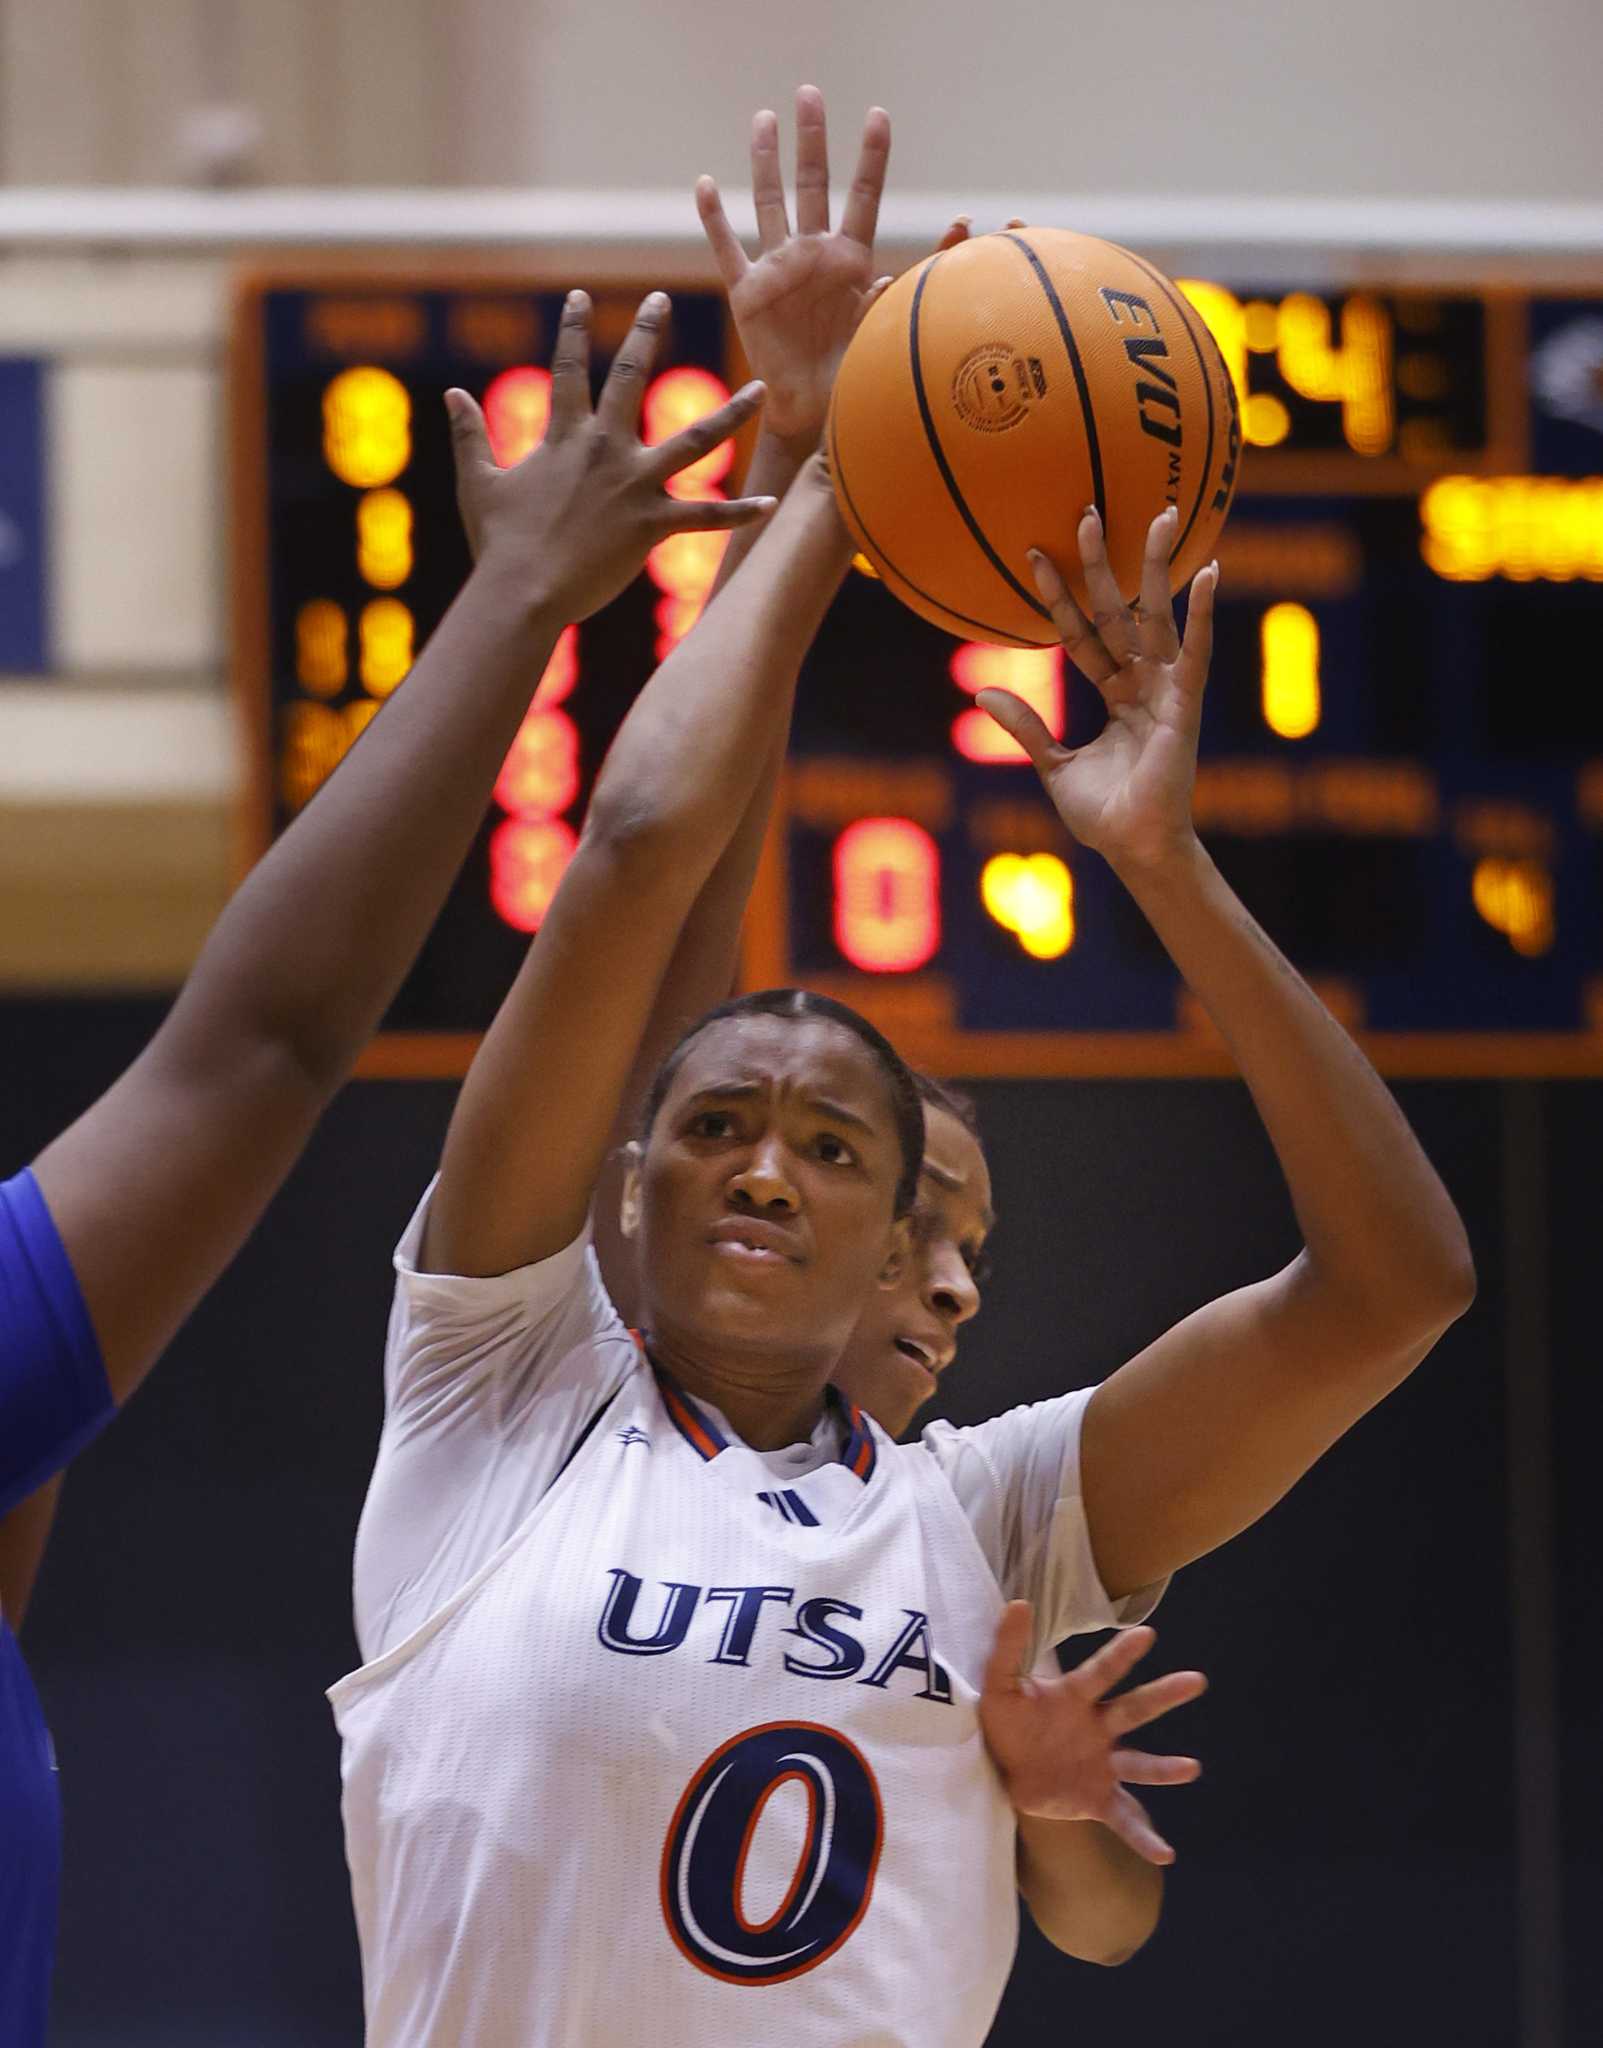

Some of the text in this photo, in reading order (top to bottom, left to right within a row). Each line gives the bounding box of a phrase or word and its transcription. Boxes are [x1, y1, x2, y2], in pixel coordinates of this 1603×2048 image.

[1099, 287, 1183, 448] EVO
[598, 1568, 955, 1705] UTSA
[660, 1720, 884, 1987] 0
